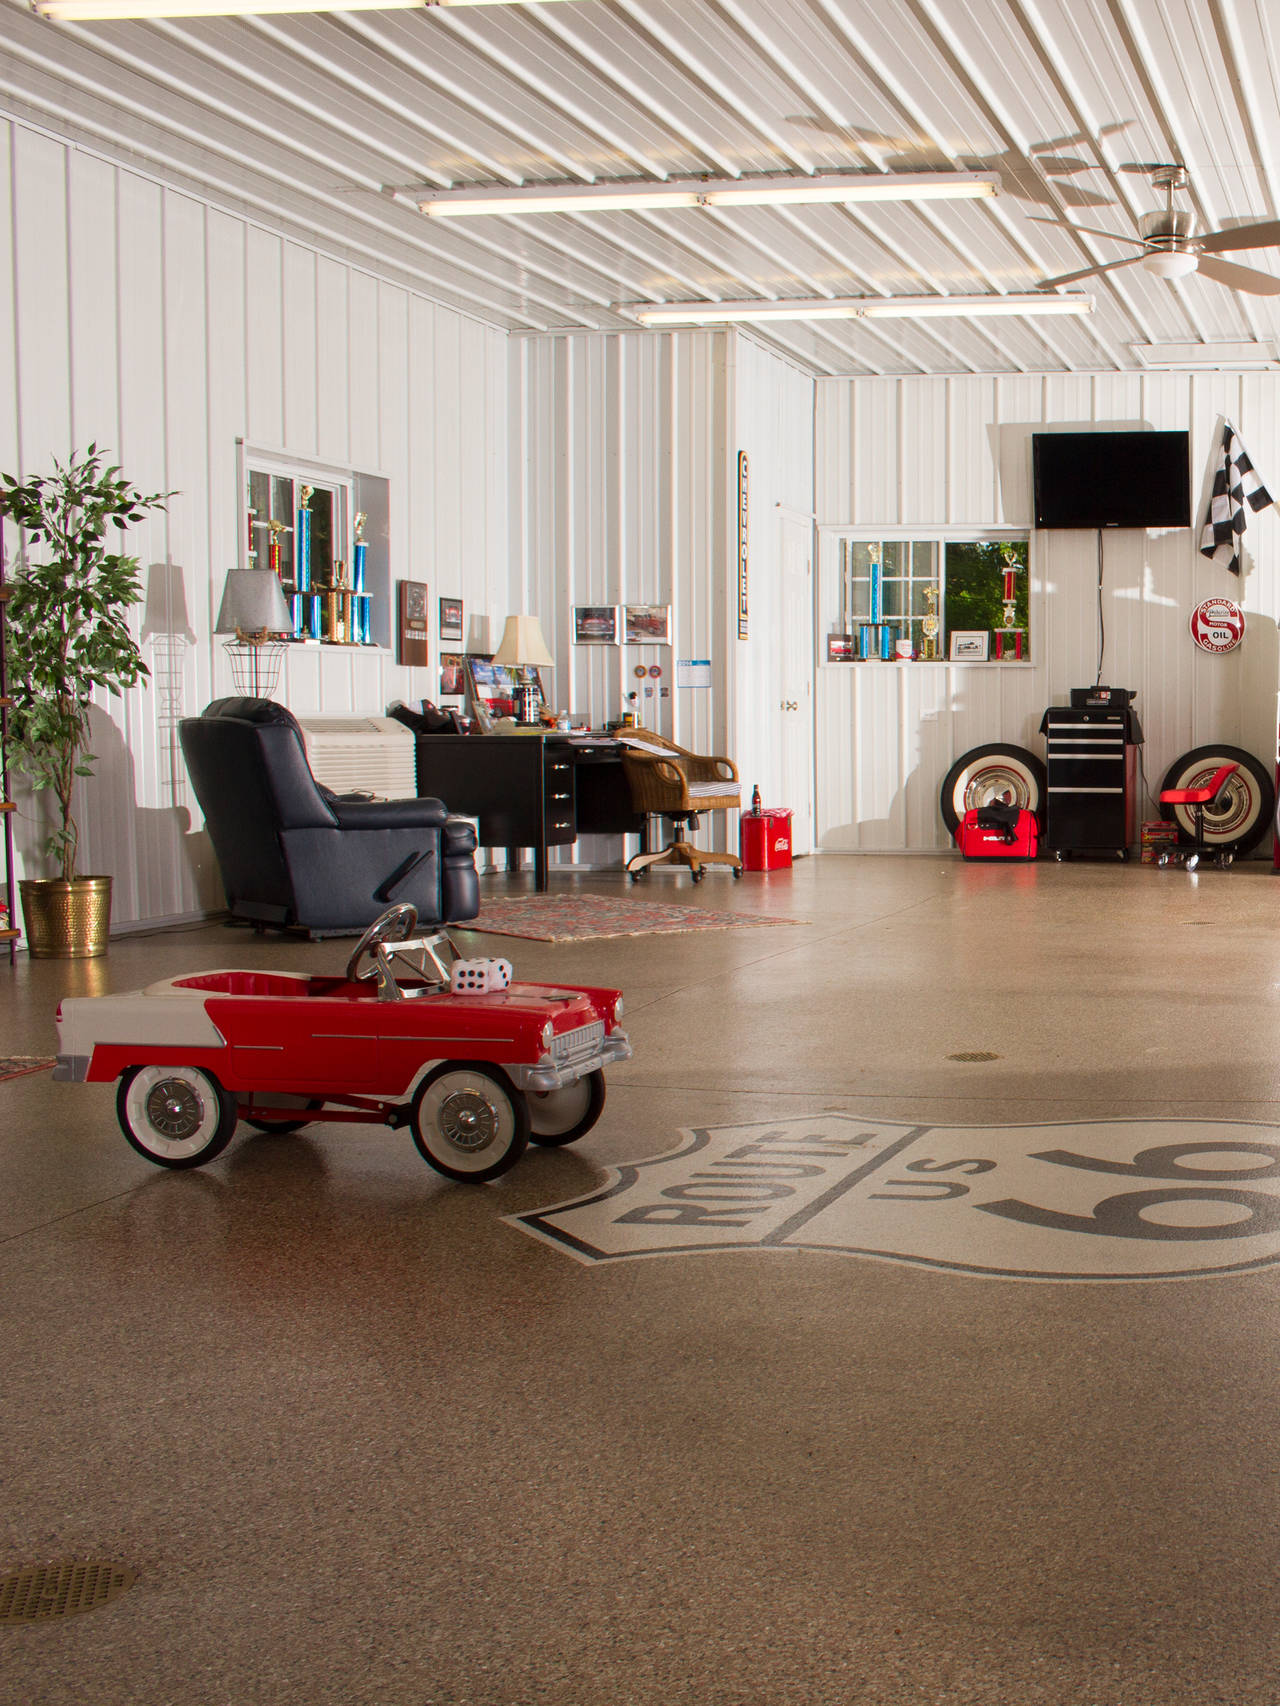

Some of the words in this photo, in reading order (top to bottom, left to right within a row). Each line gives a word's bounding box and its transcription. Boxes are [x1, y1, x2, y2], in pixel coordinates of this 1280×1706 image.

[741, 454, 749, 616] CHEVROLET
[1200, 600, 1238, 613] STANDARD
[1203, 638, 1238, 652] GASOLINE
[1212, 631, 1229, 639] OIL
[610, 1130, 880, 1228] ROUTE
[867, 1157, 998, 1202] US
